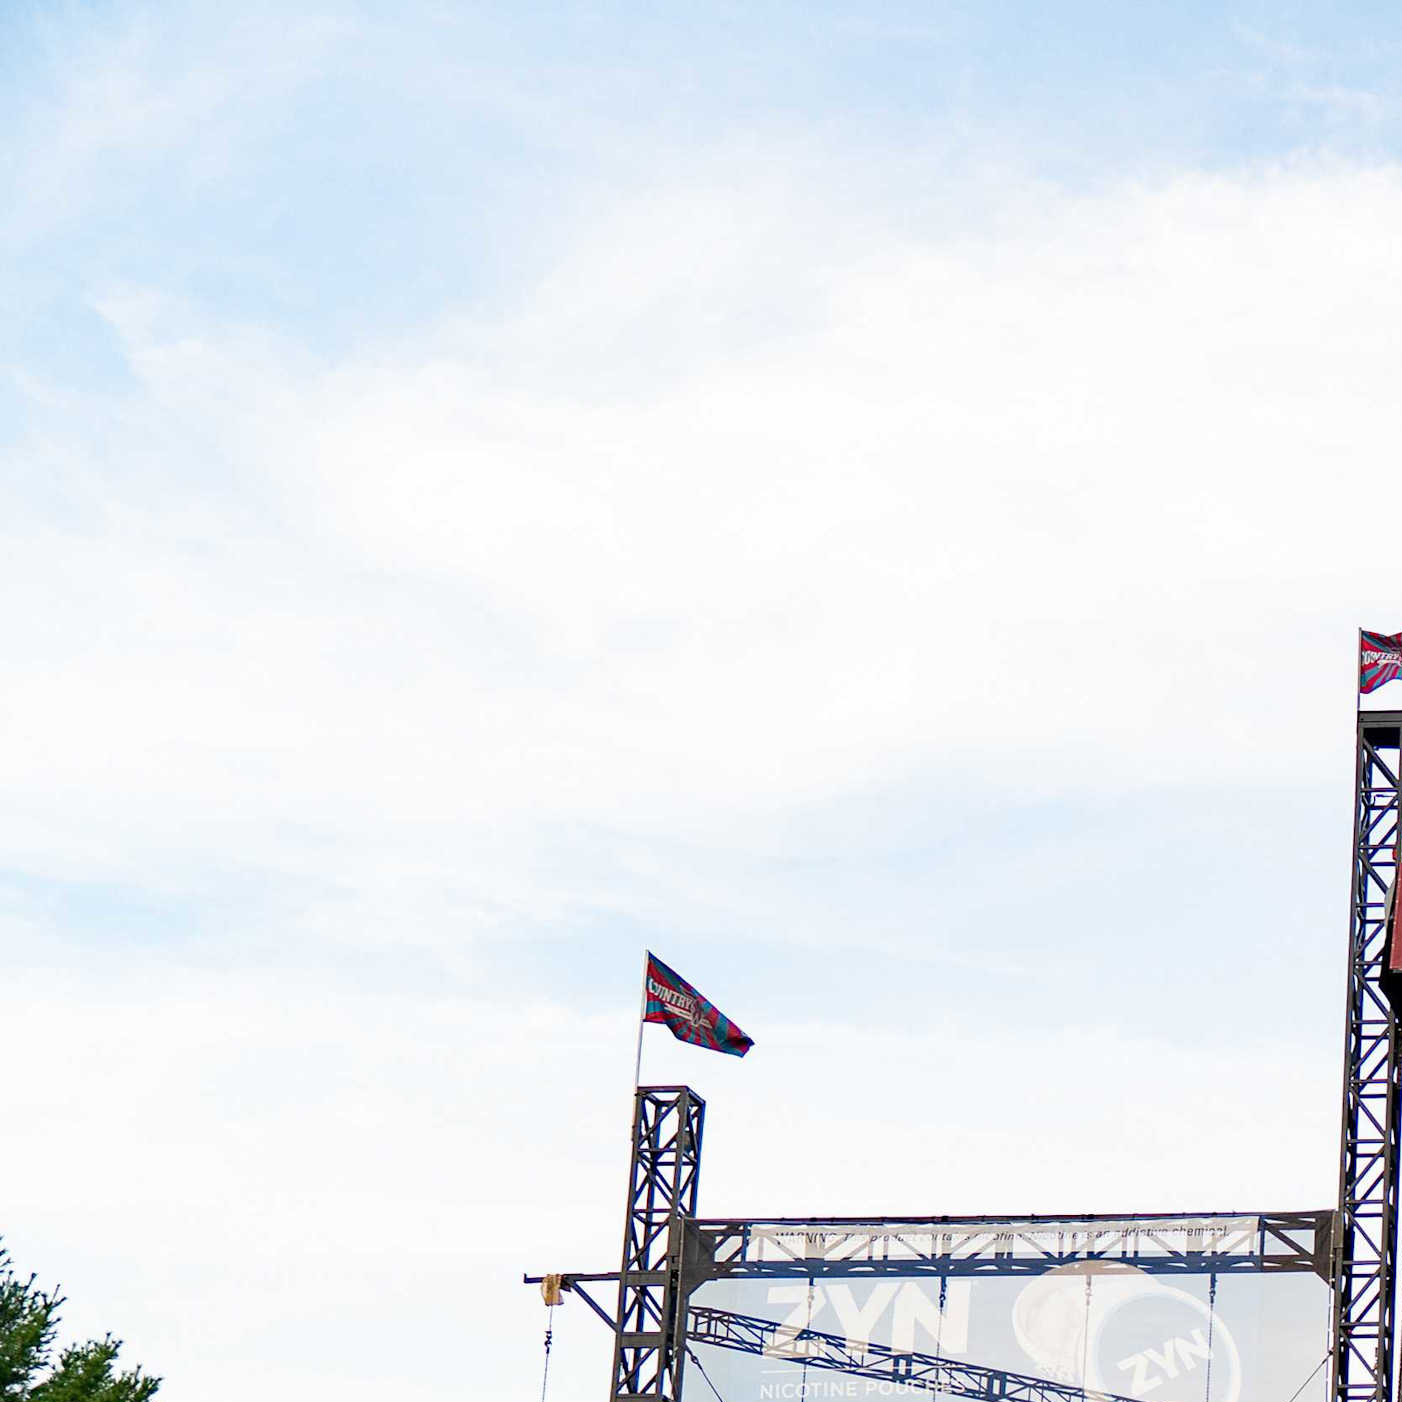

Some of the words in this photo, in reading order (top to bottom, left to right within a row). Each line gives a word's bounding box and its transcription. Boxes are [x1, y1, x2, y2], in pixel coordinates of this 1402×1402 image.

[760, 1280, 973, 1357] ZYN
[759, 1381, 858, 1400] NICOTINE
[1116, 1328, 1215, 1397] ZYN
